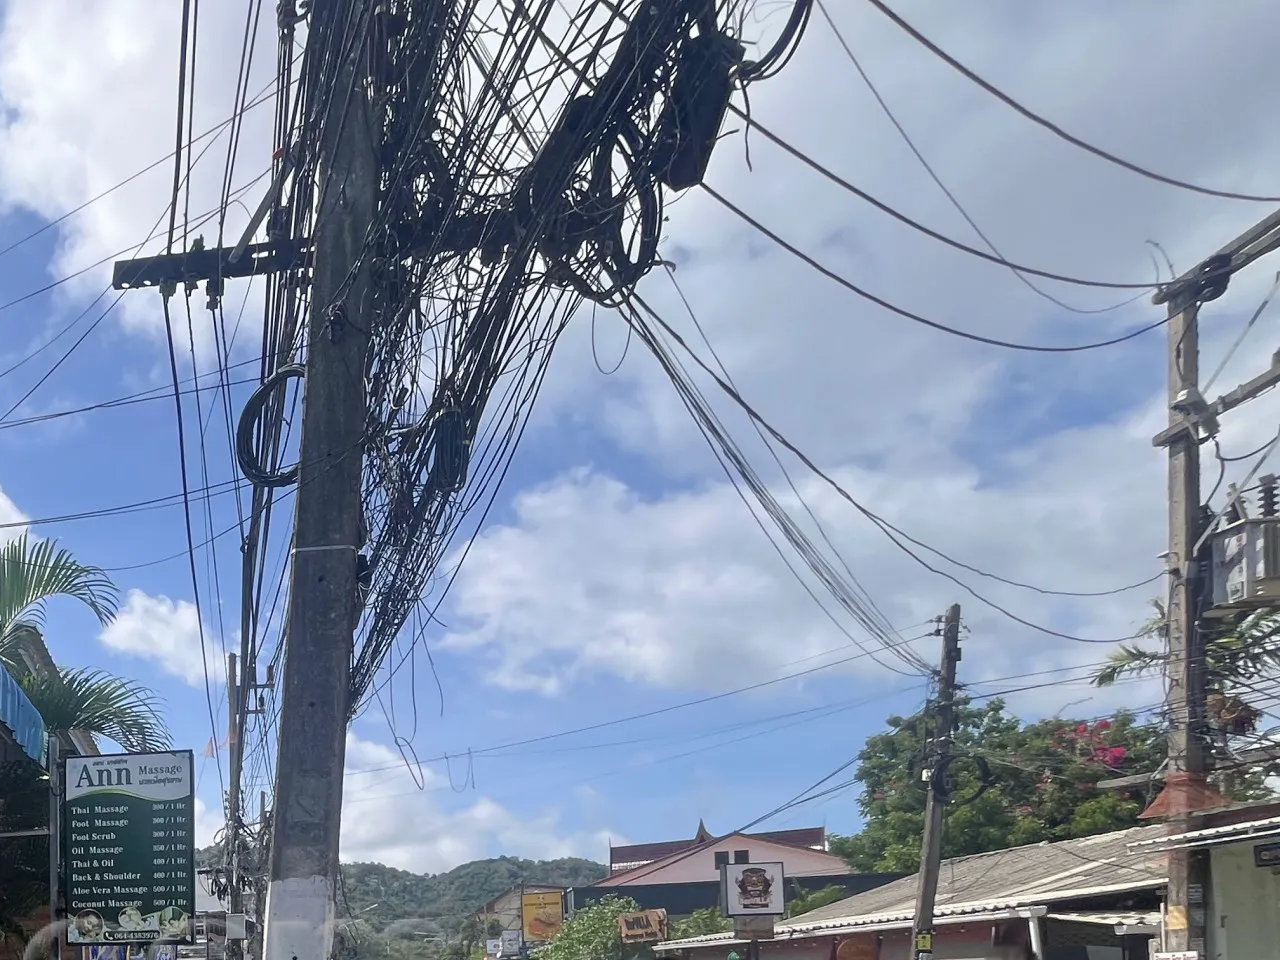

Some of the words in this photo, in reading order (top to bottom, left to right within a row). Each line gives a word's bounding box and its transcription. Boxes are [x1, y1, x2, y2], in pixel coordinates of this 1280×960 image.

[74, 764, 133, 788] Ann
[138, 765, 182, 775] Massage
[72, 820, 89, 828] Foot
[94, 819, 129, 827] Massage
[72, 833, 89, 842] Foot
[91, 832, 116, 840] Scrub
[71, 847, 84, 855] Oil
[89, 846, 124, 854] Massage
[72, 860, 90, 868] Thai
[92, 859, 99, 867] &
[101, 859, 114, 867] Oil
[72, 874, 92, 882] Back
[94, 873, 100, 881] &
[103, 872, 141, 880] Shoulder
[72, 887, 90, 895] Aloe
[92, 886, 111, 894] Vera
[113, 886, 148, 894] Massage
[108, 900, 142, 908] Massage
